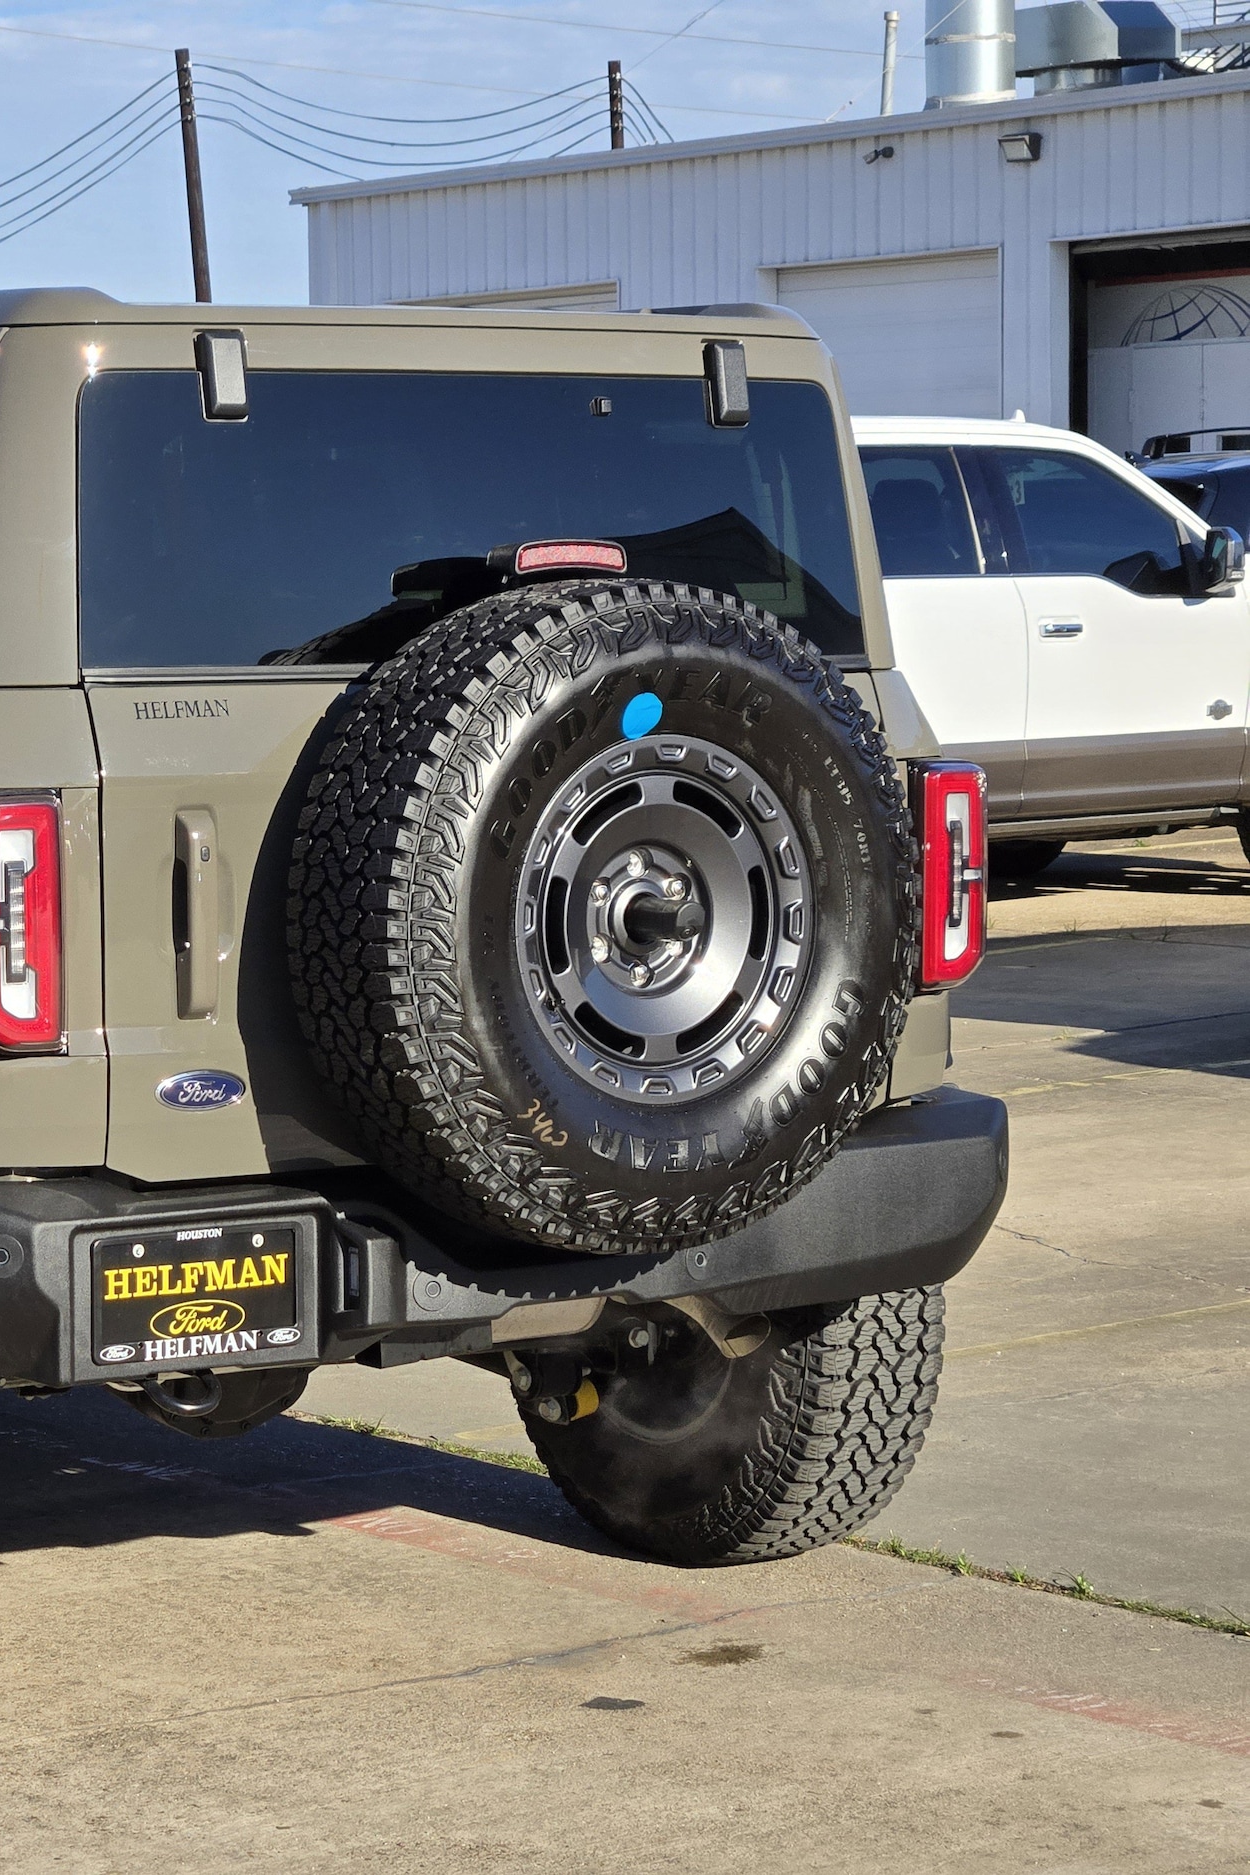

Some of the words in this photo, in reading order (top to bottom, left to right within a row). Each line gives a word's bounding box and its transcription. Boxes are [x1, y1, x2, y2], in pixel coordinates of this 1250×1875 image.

[133, 699, 230, 720] HELFMAN
[178, 1080, 227, 1103] Ford
[177, 1228, 223, 1241] HOUSTON
[104, 1253, 288, 1300] HELFMAN
[169, 1305, 228, 1334] Ford
[144, 1330, 259, 1361] HELFMAN
